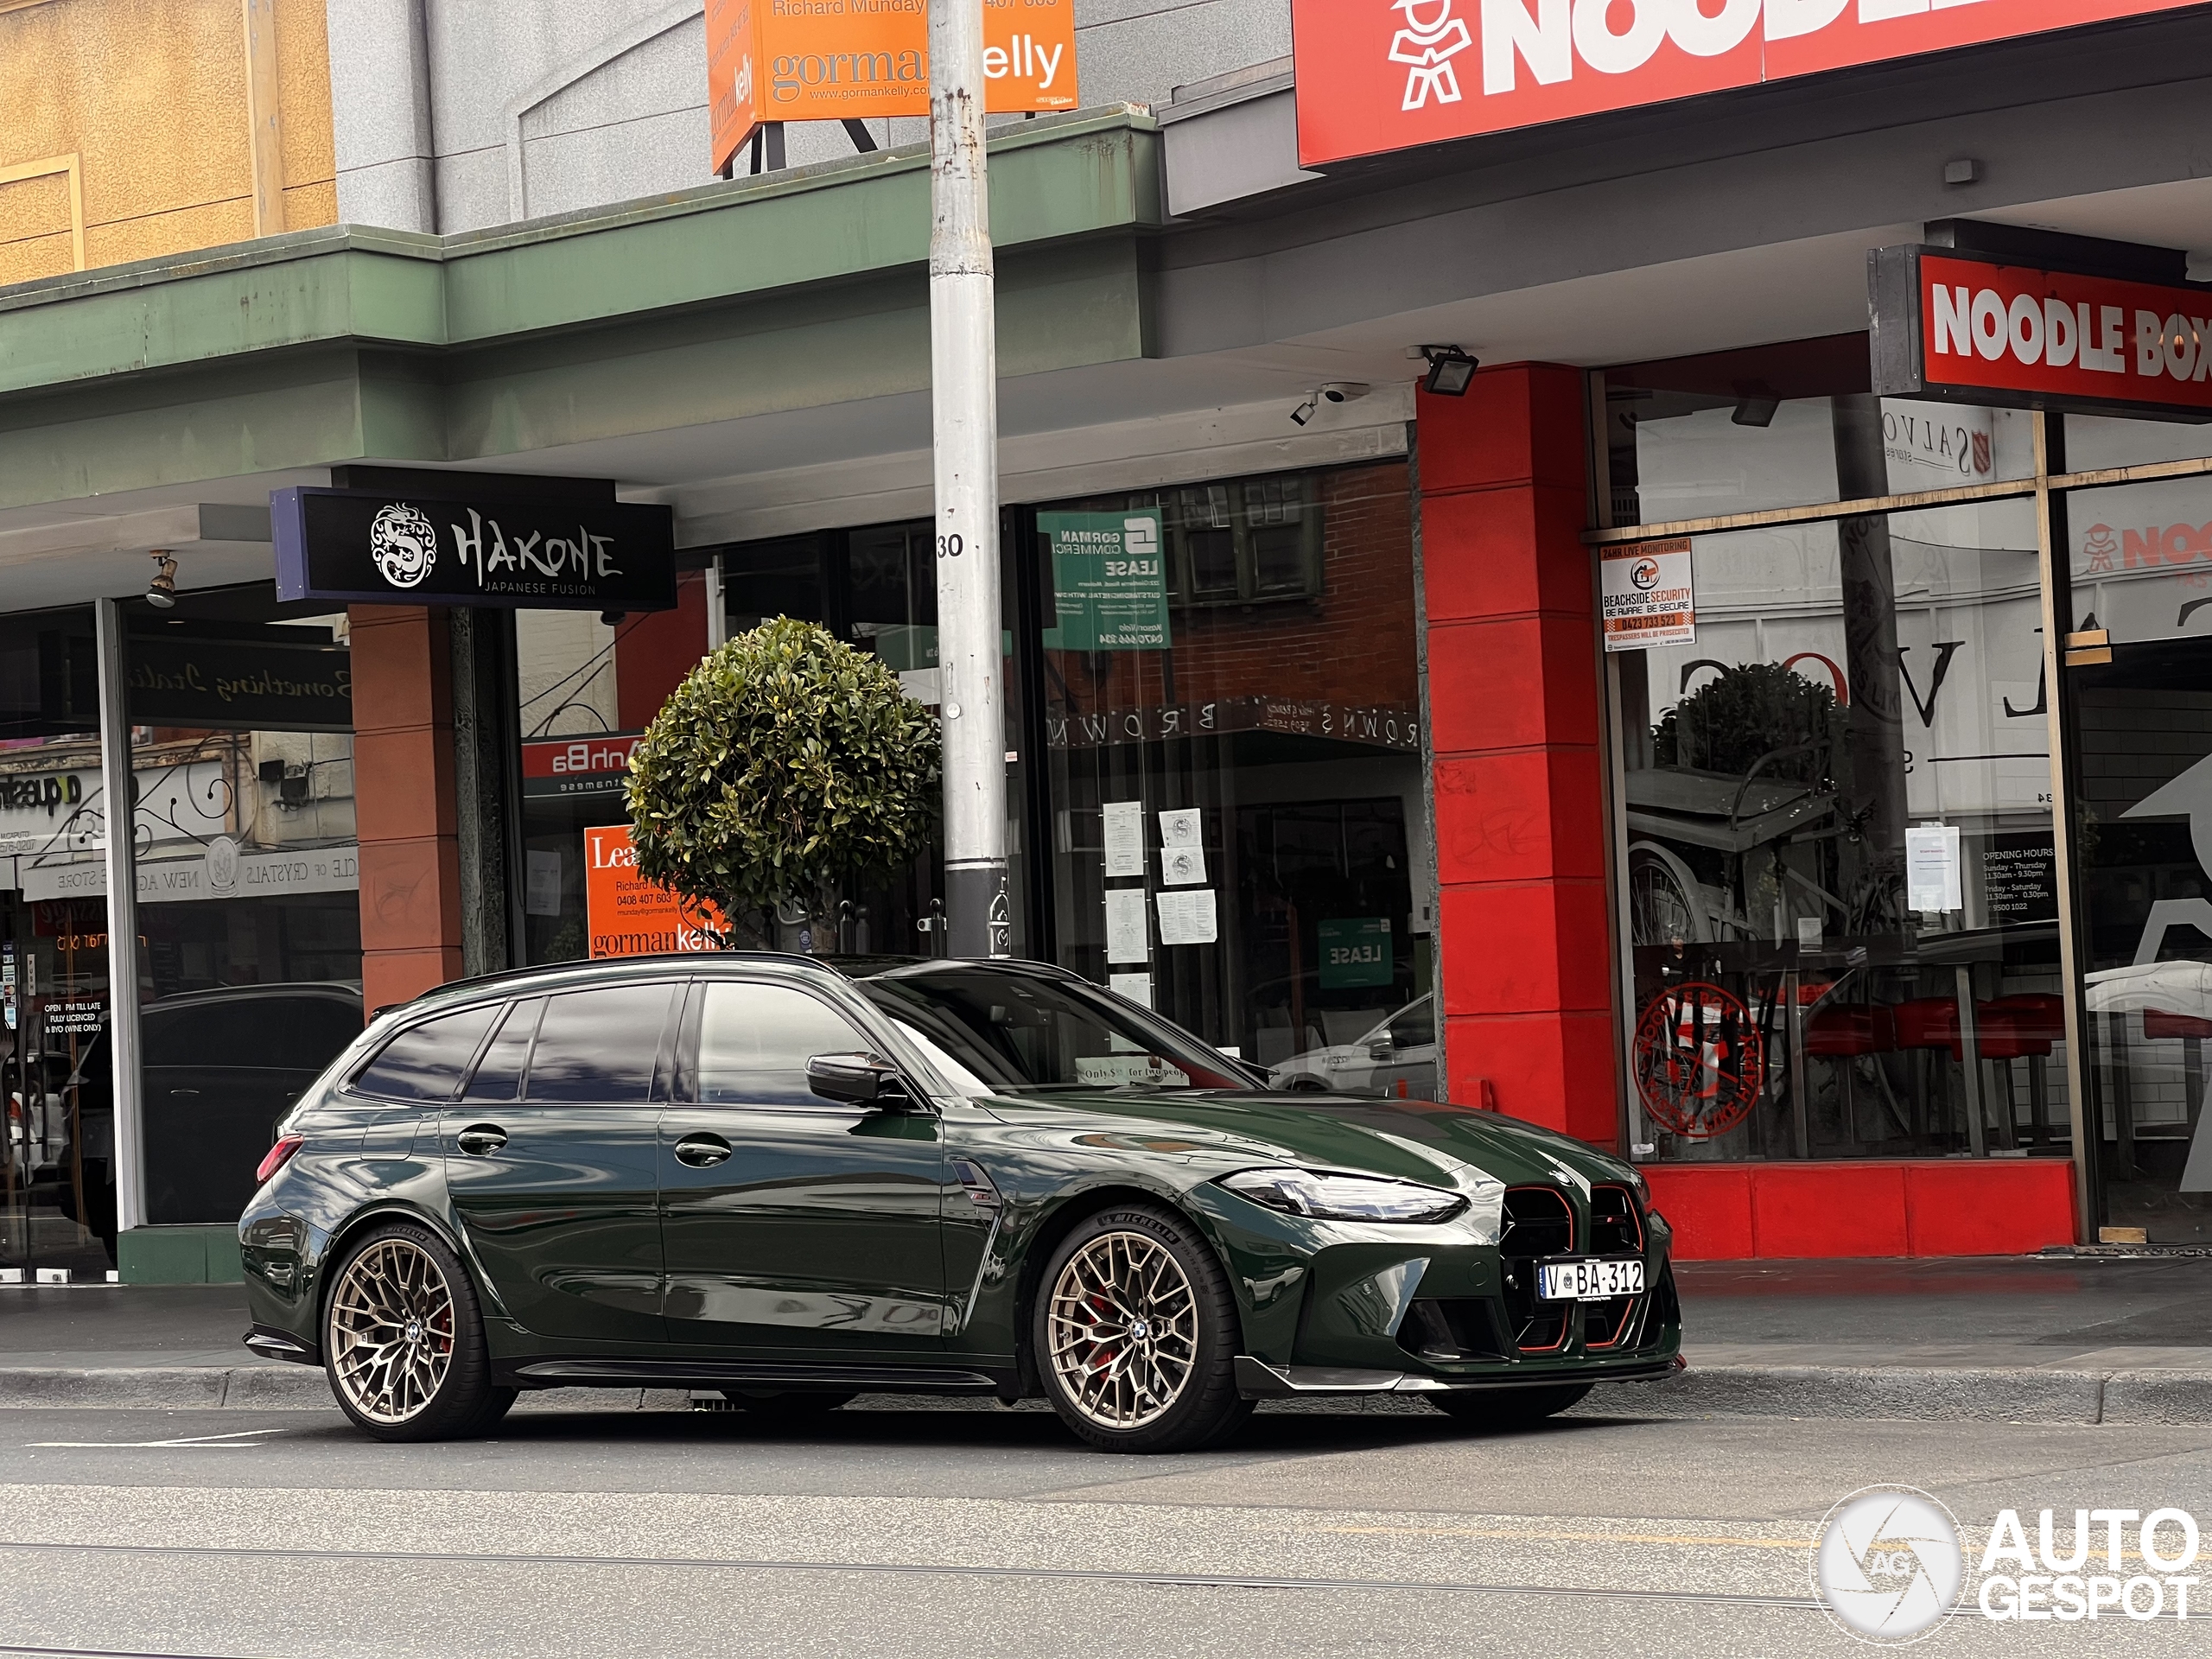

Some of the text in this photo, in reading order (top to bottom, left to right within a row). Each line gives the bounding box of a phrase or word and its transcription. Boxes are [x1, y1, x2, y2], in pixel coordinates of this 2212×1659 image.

[809, 86, 931, 103] www.gormankelly.co
[1932, 283, 2212, 383] NOODLE BOX
[451, 507, 624, 588] HAKONE
[937, 533, 963, 558] 30
[1603, 540, 1688, 559] 24HR LIVE MONITORING
[484, 581, 596, 596] JAPANESE FUSION
[1604, 588, 1691, 607] BEACHSIDE SECURITY
[1605, 601, 1689, 617] BE AWARE BE SECURE
[1622, 614, 1676, 630] 0423 733 523
[1608, 632, 1641, 641] TRESPASSERS
[1641, 631, 1652, 639] WILL
[591, 836, 641, 869] Lea
[1982, 850, 2023, 861] OPENING
[1983, 863, 2009, 872] Sunday
[2014, 861, 2047, 870] Thursday
[2011, 883, 2042, 892] Saturday
[617, 893, 671, 906] 0408 407 603
[44, 1004, 61, 1013] OPEN
[75, 1002, 86, 1011] TILL
[86, 1001, 101, 1010] LATE
[50, 1014, 66, 1023] FULLY
[1084, 1069, 1108, 1079] Only
[1128, 1068, 1142, 1077] for
[1163, 1068, 1185, 1079] peop
[1115, 1213, 1178, 1243] MICHELIN
[1548, 1266, 1559, 1296] V
